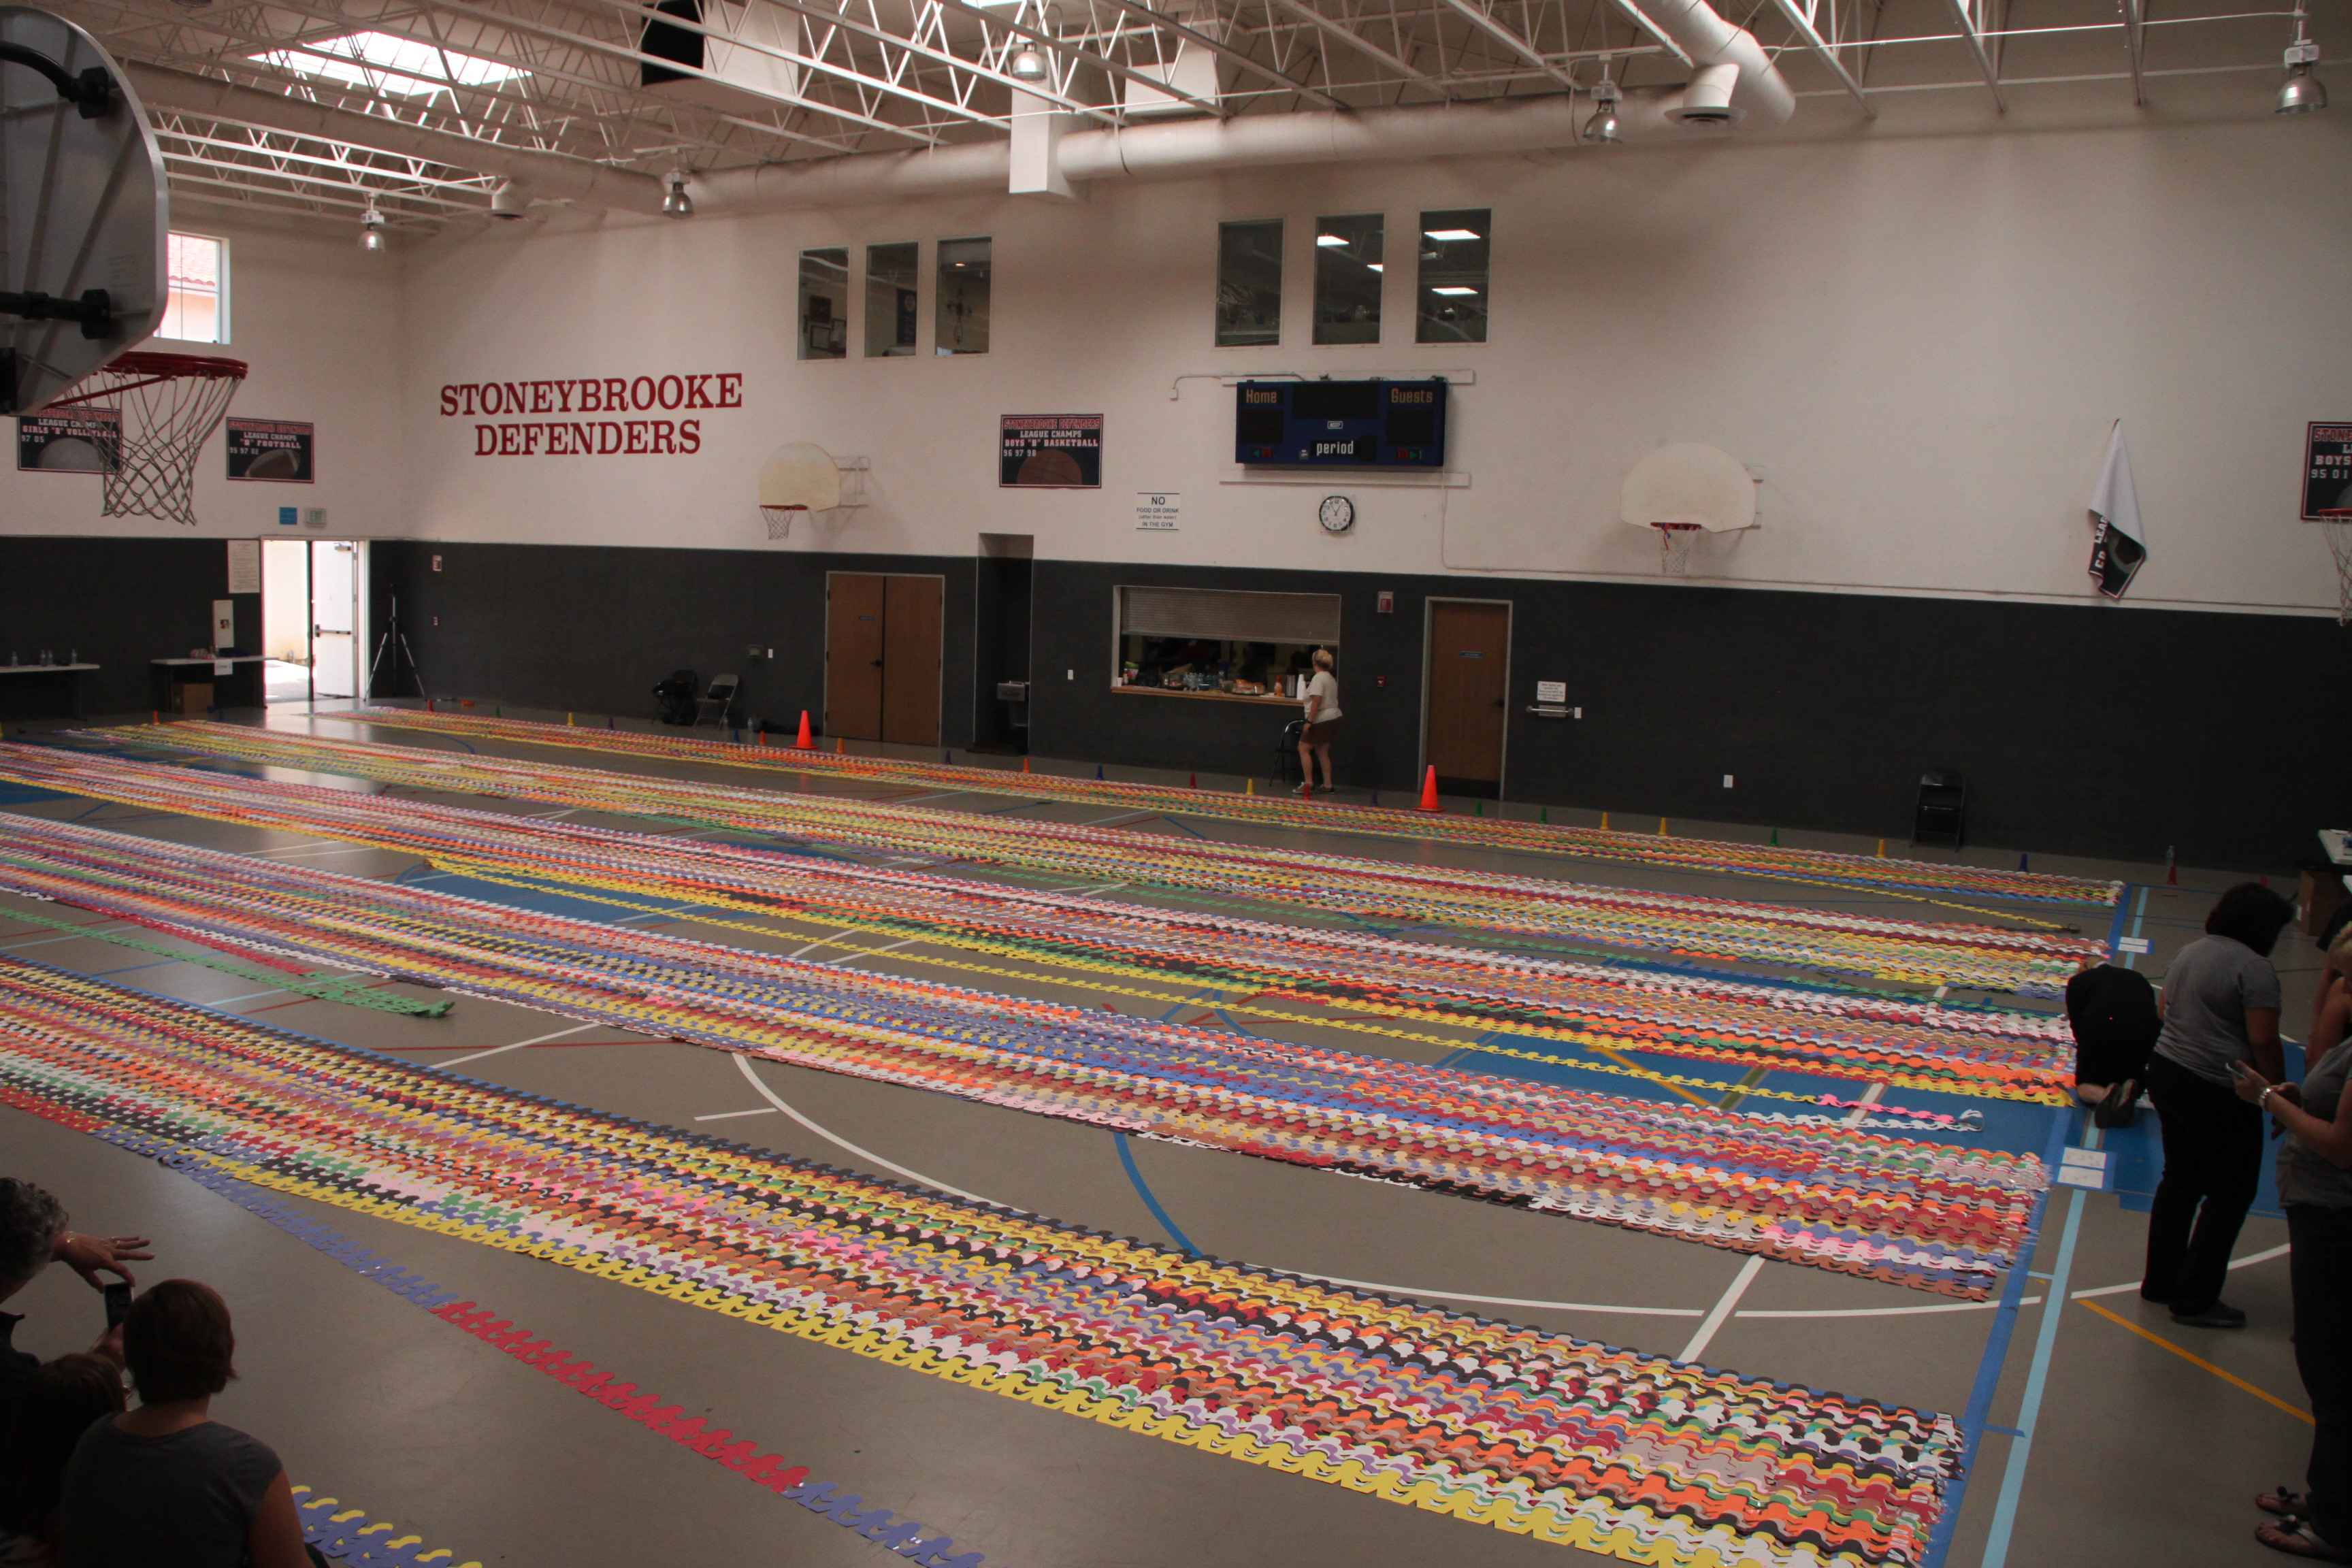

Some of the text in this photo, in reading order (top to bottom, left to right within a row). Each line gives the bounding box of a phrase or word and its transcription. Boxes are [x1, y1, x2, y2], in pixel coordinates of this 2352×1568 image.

[440, 373, 742, 416] STONEYBROOKE
[1246, 389, 1277, 403] Home
[1391, 388, 1433, 403] Guests
[38, 419, 97, 429] LEAGUE CHMP
[1004, 418, 1100, 429] STONEYBROOKE DEFENDERS
[22, 425, 48, 434] GIRLS
[66, 428, 117, 438] VOLLYBAL
[244, 431, 297, 441] LEAGUE CHAMPS
[475, 419, 700, 456] DEFENDERS
[257, 440, 301, 448] FOOTBALL
[1316, 440, 1354, 456] period
[2315, 455, 2351, 465] BOYS
[2311, 469, 2348, 478] 95 01
[1152, 496, 1165, 505] NO
